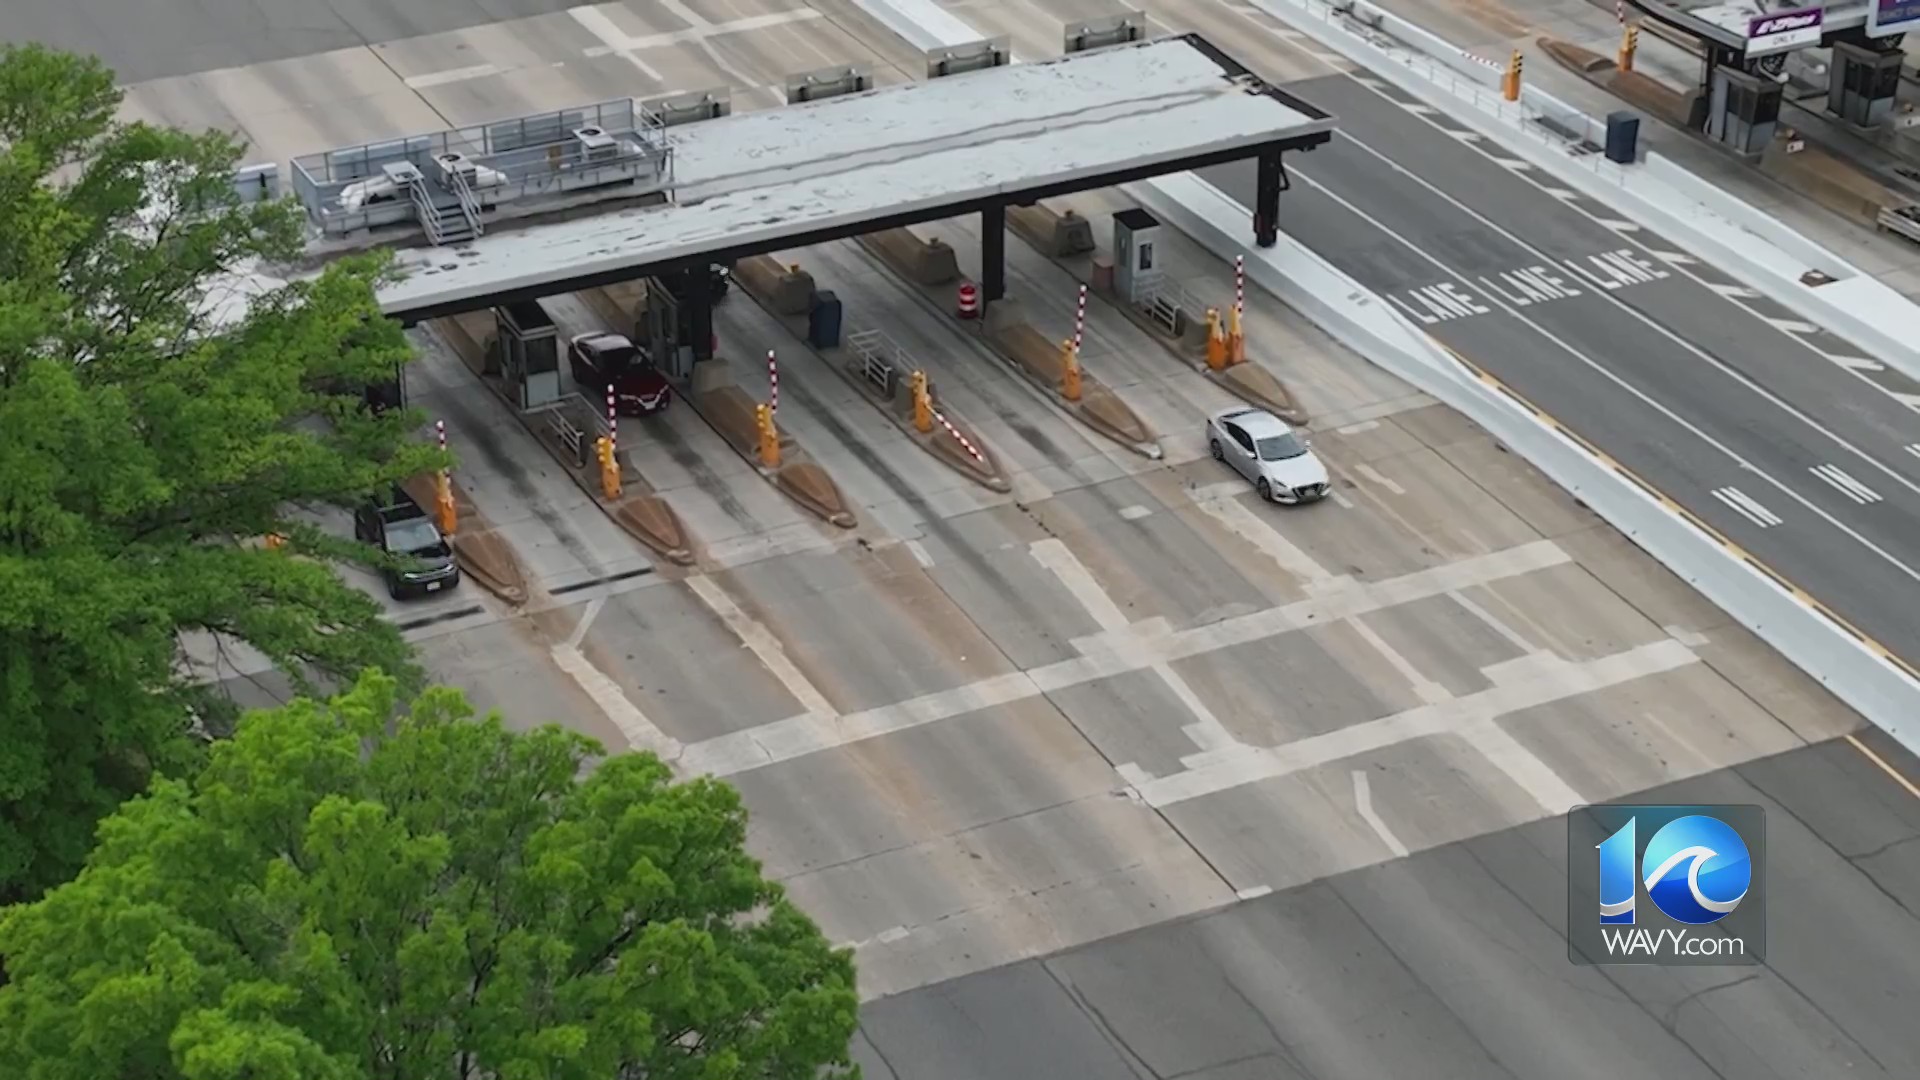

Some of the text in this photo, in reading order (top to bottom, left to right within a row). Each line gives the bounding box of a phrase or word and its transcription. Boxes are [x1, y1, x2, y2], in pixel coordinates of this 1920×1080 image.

[1386, 249, 1670, 323] LANE LANE LANE
